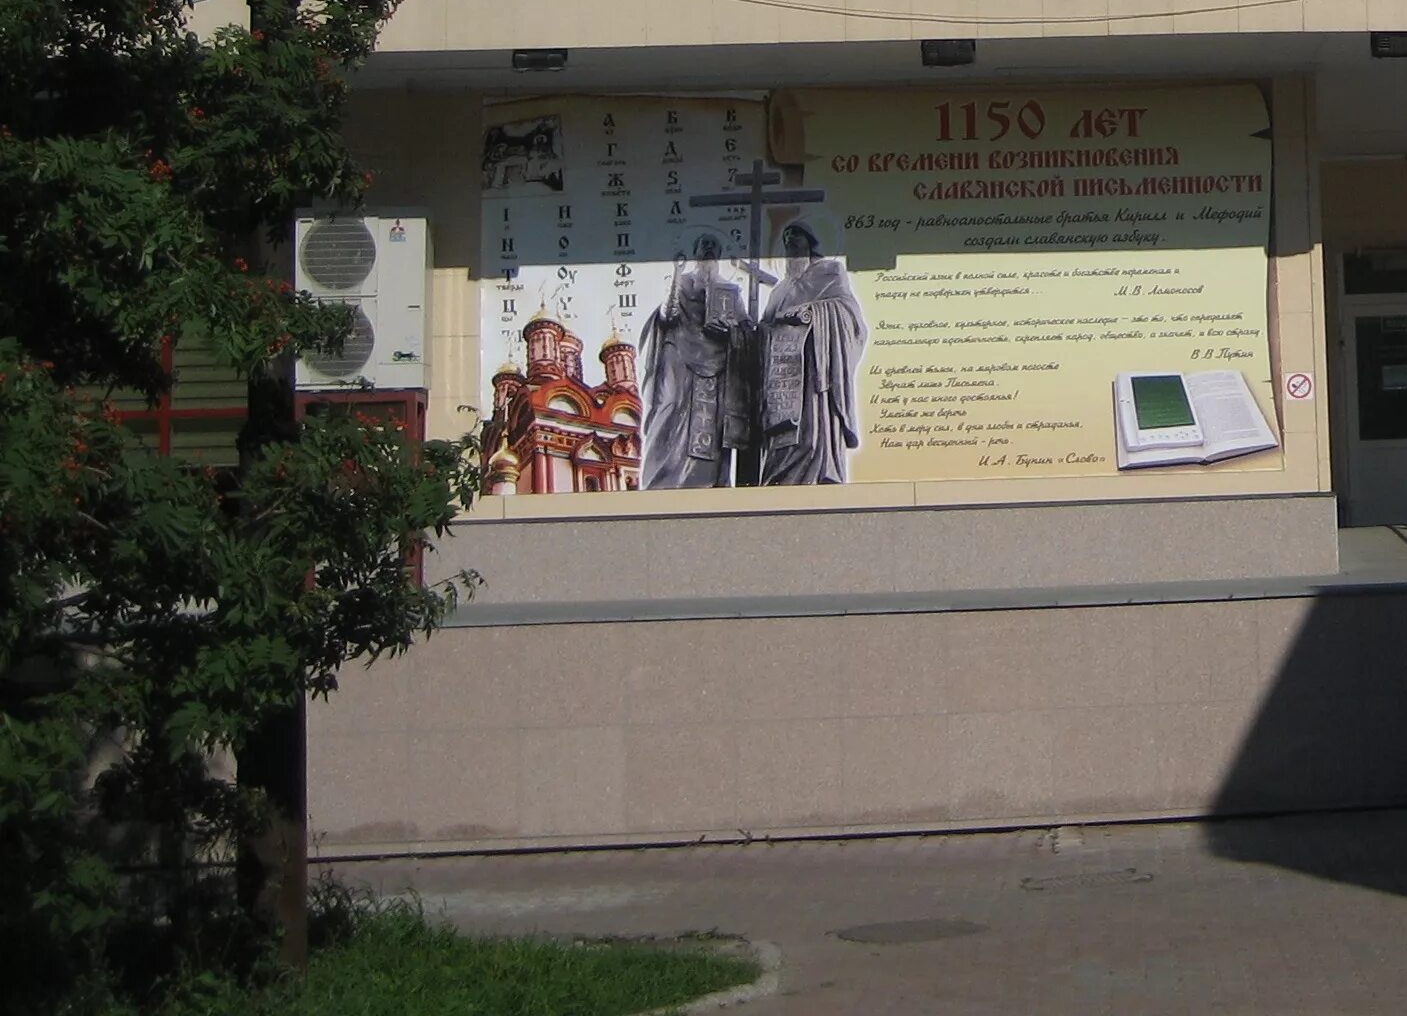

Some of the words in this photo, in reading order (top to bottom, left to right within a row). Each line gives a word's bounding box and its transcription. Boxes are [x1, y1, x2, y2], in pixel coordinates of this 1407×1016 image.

[933, 99, 1046, 142] 1150
[844, 214, 875, 230] 863
[878, 219, 901, 232] год
[1056, 210, 1109, 227] братья
[1114, 207, 1167, 227] Кирилл
[1175, 211, 1184, 220] и
[1193, 205, 1264, 224] Мефодий
[964, 233, 1020, 250] создали
[1024, 230, 1107, 247] славянскую
[1148, 284, 1204, 295] Ломоносов
[1015, 454, 1053, 466] Бунин
